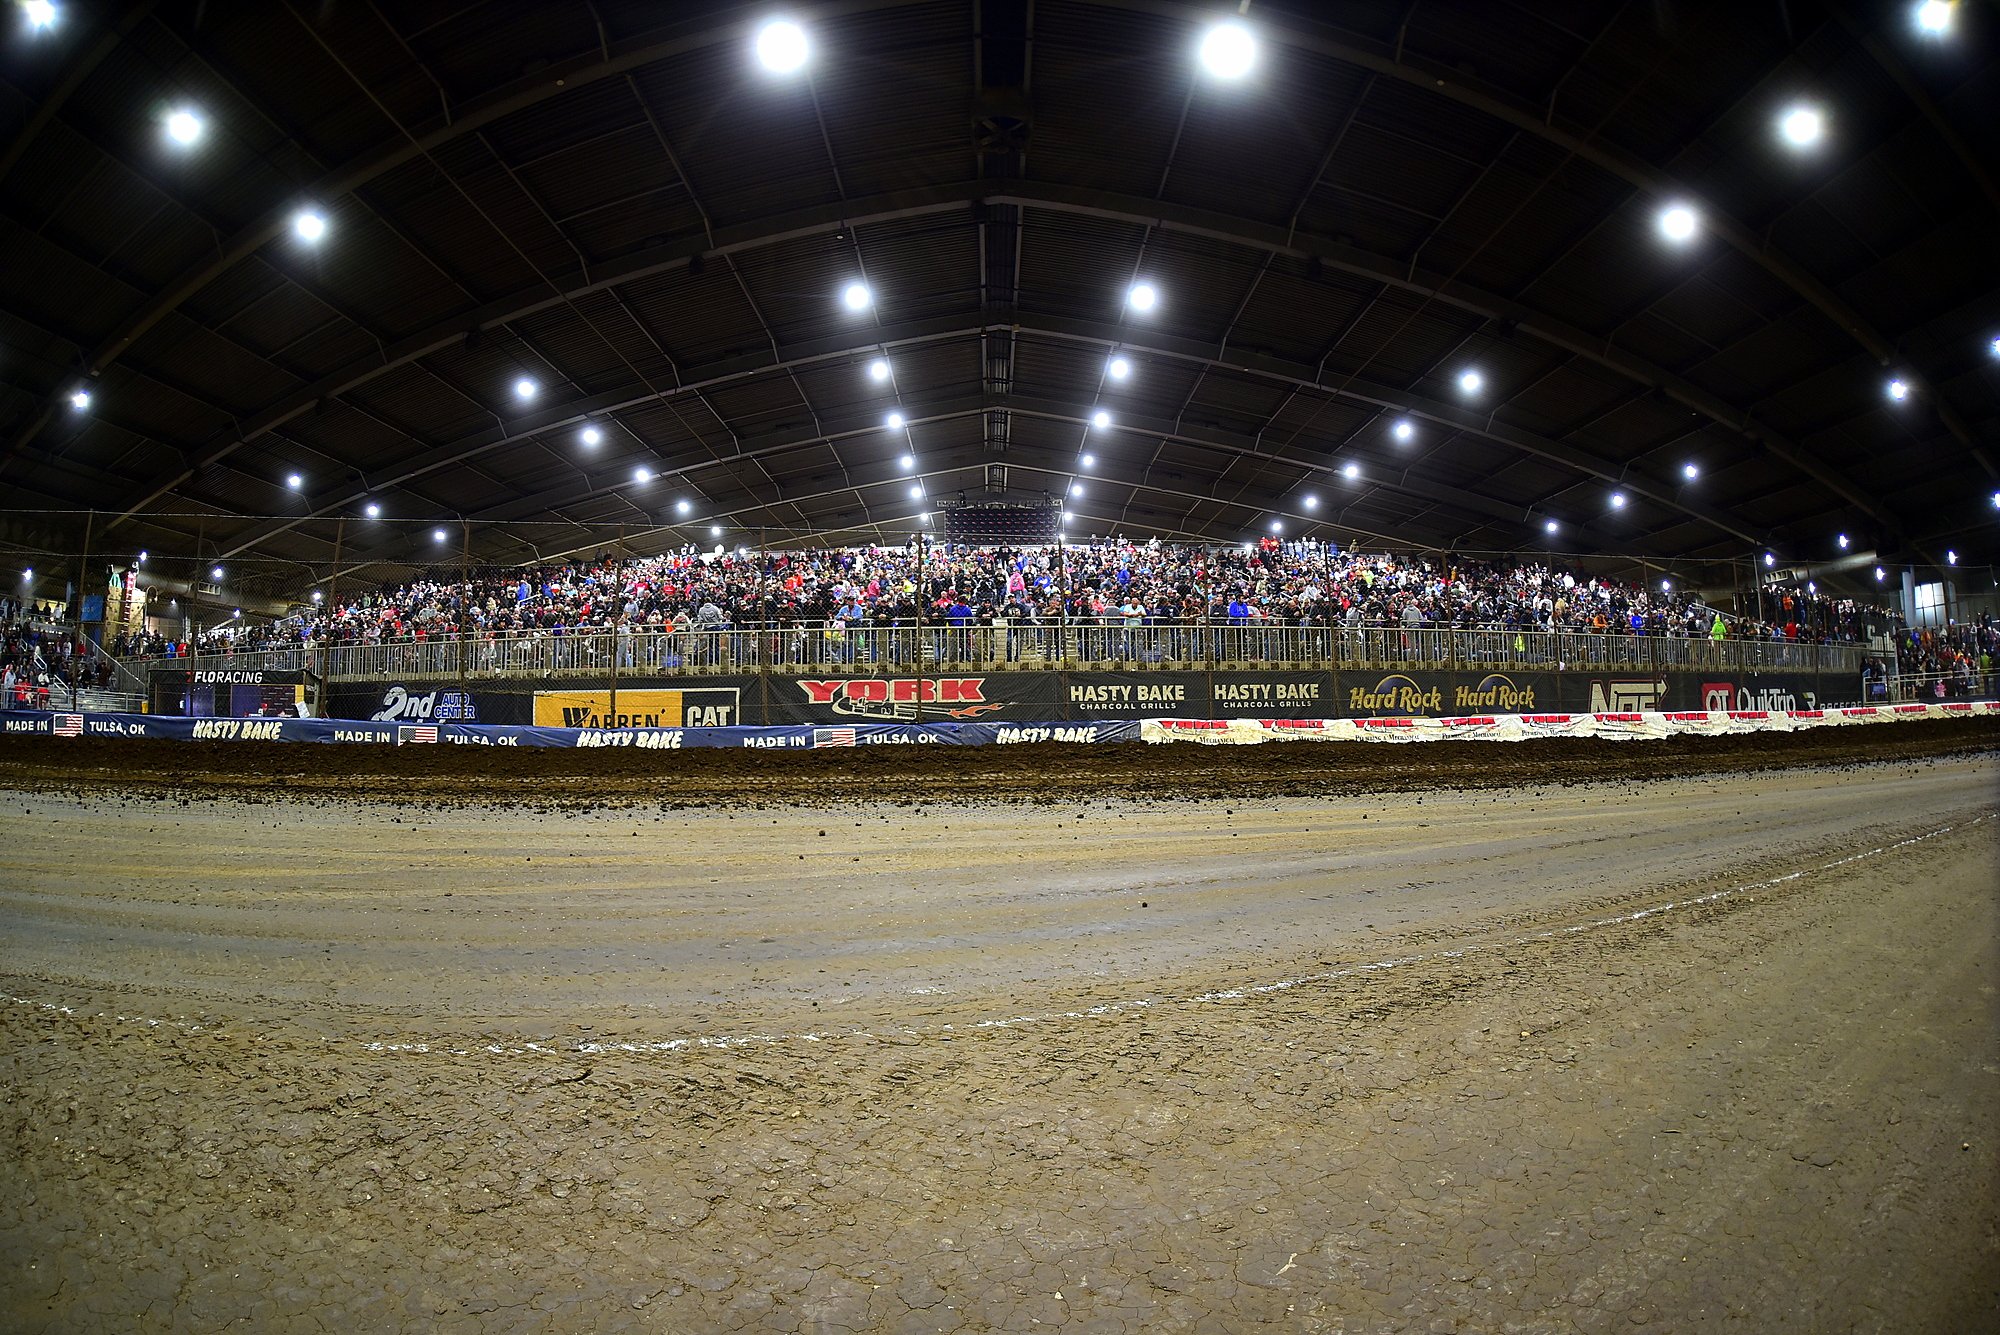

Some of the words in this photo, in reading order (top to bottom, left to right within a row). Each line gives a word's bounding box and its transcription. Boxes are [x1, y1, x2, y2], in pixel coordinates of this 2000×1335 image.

[797, 678, 986, 704] YORK
[1070, 685, 1131, 701] HASTY
[1137, 685, 1185, 701] BAKE
[1214, 684, 1271, 700] HASTY
[1276, 684, 1319, 700] BAKE
[1455, 685, 1497, 707] Hard
[1499, 685, 1535, 710] Rock
[1737, 687, 1796, 711] QuikTrip
[442, 693, 470, 706] AUTO
[1080, 702, 1136, 710] CHARCOAL
[1141, 702, 1176, 710] GRILLS
[1223, 701, 1275, 709] CHARCOAL
[1279, 700, 1311, 708] GRILLS
[1350, 686, 1397, 710] Hard
[1400, 686, 1443, 713] Rock
[434, 706, 475, 719] CENTER
[687, 706, 730, 726] CAT
[6, 720, 34, 731] MADE
[37, 720, 48, 731] IN
[89, 721, 127, 735] TULSA,
[129, 724, 146, 735] OK
[192, 720, 240, 739] HASTY
[240, 721, 283, 740] BAKE
[996, 727, 1050, 744] HASTY
[1053, 727, 1098, 743] BAKE
[334, 731, 372, 742] MADE
[376, 731, 390, 742] IN
[498, 736, 517, 746] OK
[576, 731, 633, 748] HASTY
[635, 731, 684, 749] BAKE
[744, 736, 788, 748] MADE
[791, 736, 806, 747] IN
[865, 734, 914, 745] TULSA,
[918, 733, 938, 744] OK
